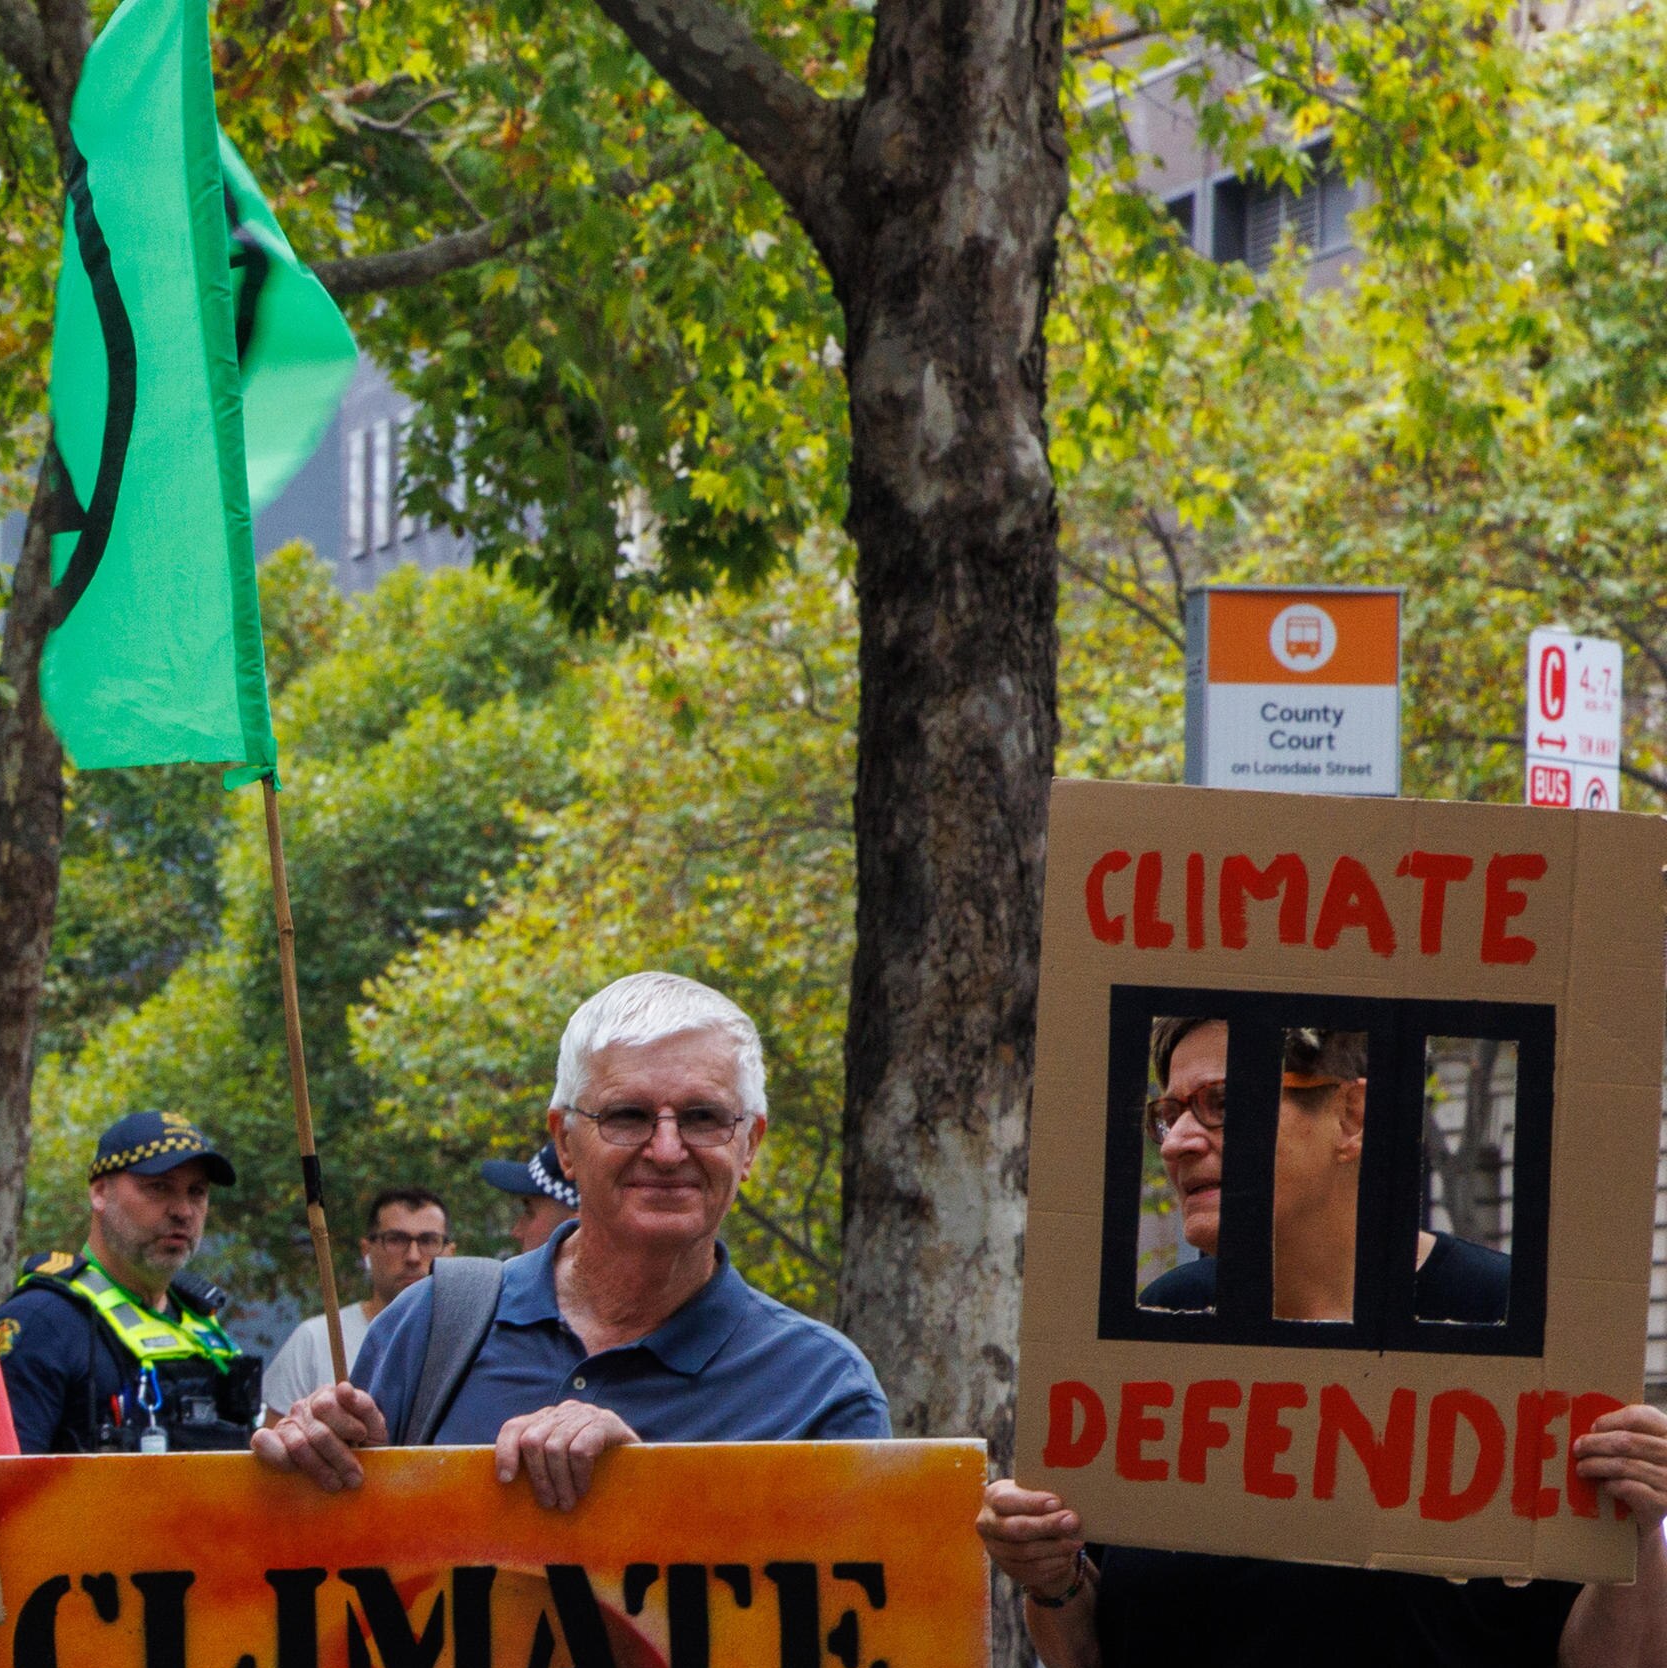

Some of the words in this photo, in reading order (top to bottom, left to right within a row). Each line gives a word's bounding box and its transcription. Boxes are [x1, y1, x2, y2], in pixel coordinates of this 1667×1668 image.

[1260, 702, 1344, 728] County
[1268, 730, 1336, 750] Court
[1231, 763, 1250, 774] on
[1254, 761, 1321, 775] Lonsdale
[1326, 762, 1372, 776] Street
[1534, 768, 1567, 803] BUS
[1085, 849, 1547, 965] CLIMATE
